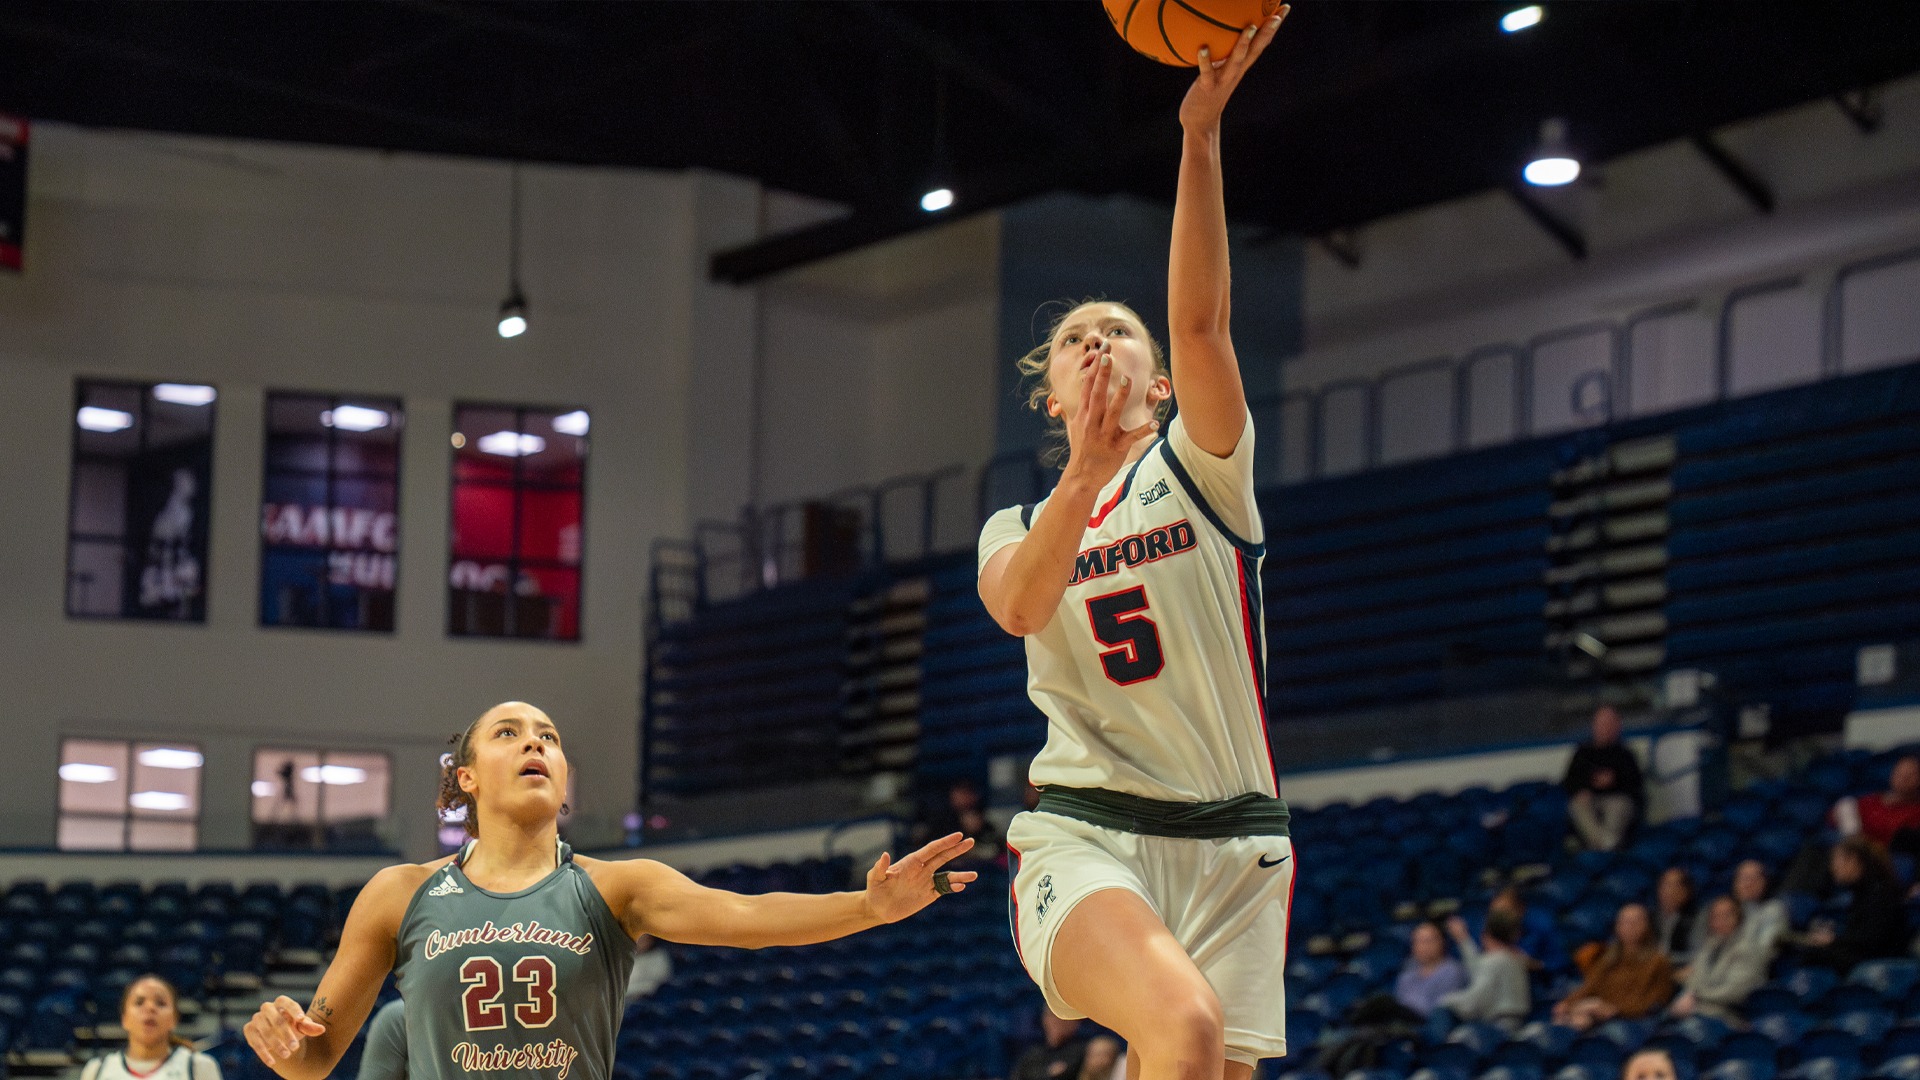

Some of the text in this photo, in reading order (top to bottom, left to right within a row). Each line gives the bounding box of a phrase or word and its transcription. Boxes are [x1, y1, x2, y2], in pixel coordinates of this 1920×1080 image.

[1139, 477, 1172, 506] SOCON
[1068, 518, 1198, 586] MFORD
[1085, 584, 1165, 687] 5
[428, 886, 464, 897] adidas
[425, 921, 593, 960] Cumberland
[459, 955, 558, 1032] 23
[452, 1038, 578, 1080] University
